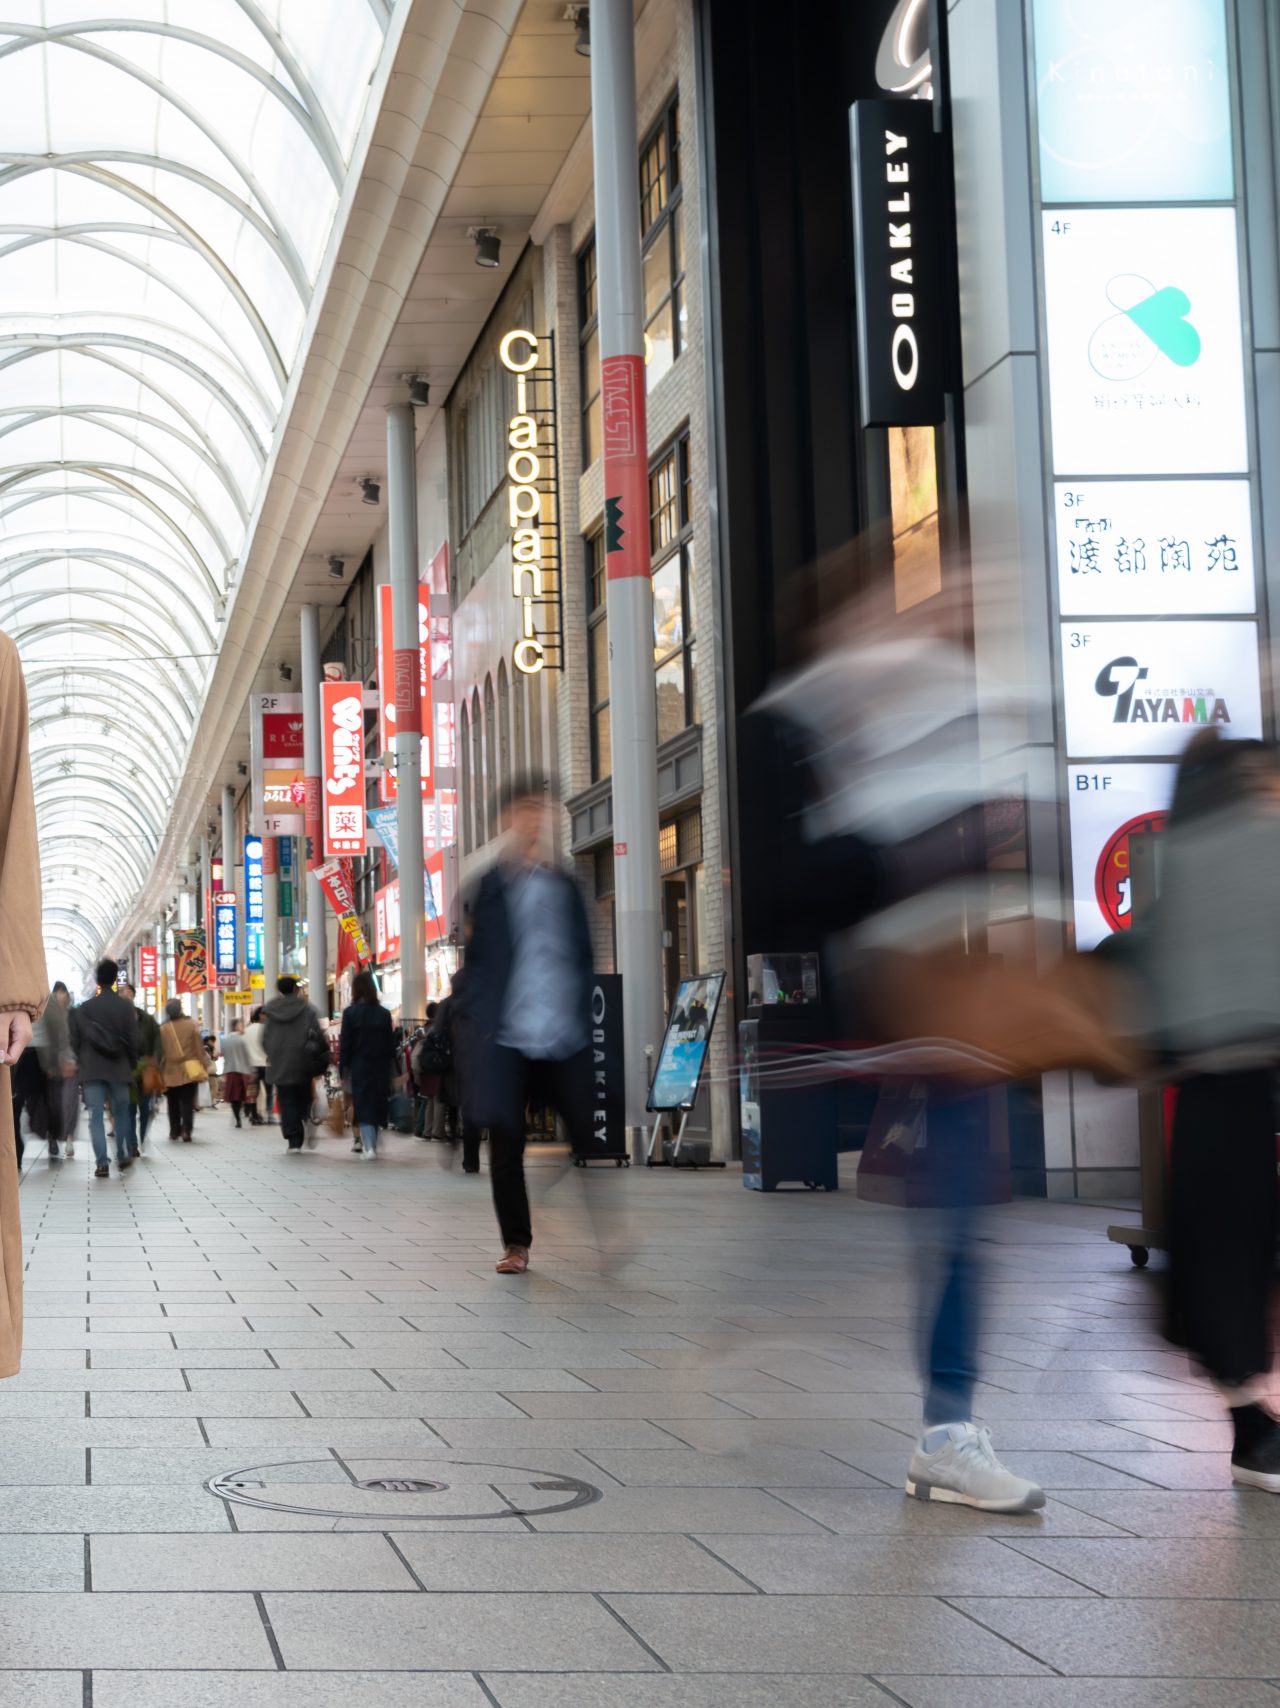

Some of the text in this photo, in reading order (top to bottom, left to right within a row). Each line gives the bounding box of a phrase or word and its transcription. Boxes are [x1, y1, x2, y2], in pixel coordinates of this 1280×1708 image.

[884, 129, 914, 318] OAKLEY
[1051, 220, 1072, 235] 4F
[498, 328, 545, 675] Ciaopanic
[1063, 492, 1086, 507] 3F
[1069, 632, 1092, 648] 3F
[261, 697, 278, 708] 2F
[269, 734, 303, 742] RIC
[326, 696, 362, 795] Wants
[1075, 774, 1112, 791] B1F
[264, 819, 281, 831] 1F
[335, 811, 357, 833] 薬
